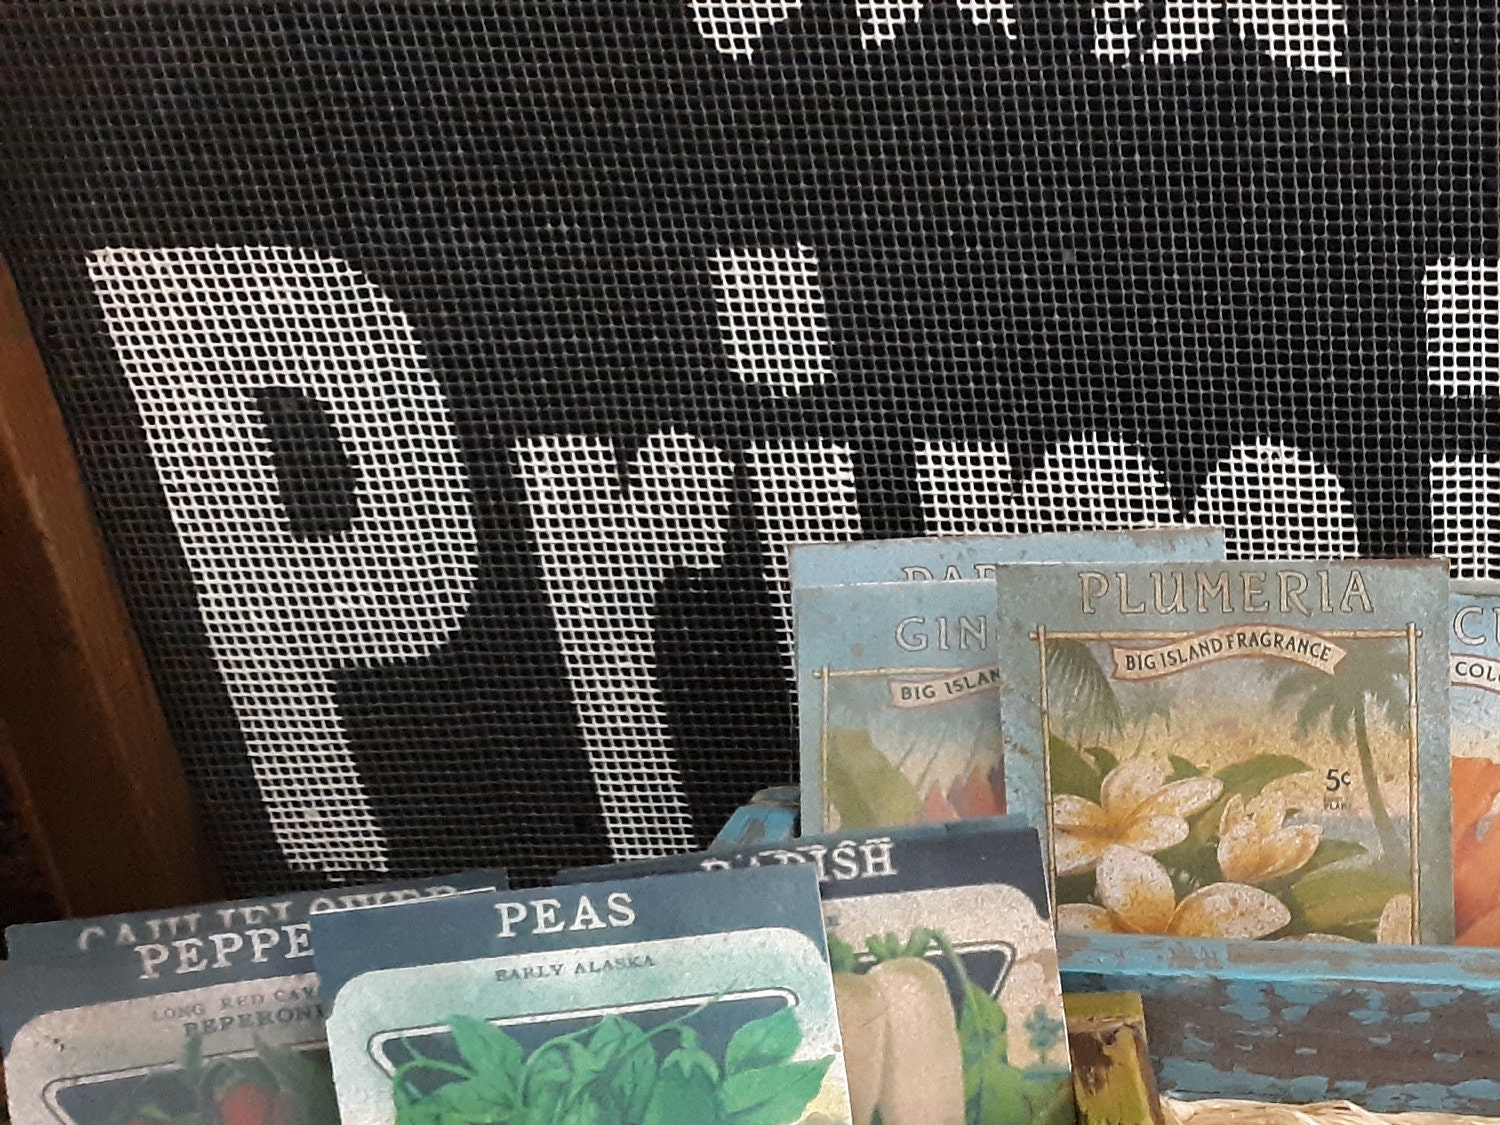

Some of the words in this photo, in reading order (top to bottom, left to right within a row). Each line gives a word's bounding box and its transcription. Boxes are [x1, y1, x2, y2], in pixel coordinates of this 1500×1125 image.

[1078, 570, 1374, 617] PLUMERIA
[895, 615, 998, 652] GIN
[1125, 652, 1156, 671] BIG
[1161, 637, 1223, 668] ISLAND
[1226, 632, 1332, 662] FRAGRANCE
[901, 684, 936, 700] BIG
[494, 892, 636, 938] PEAS
[495, 963, 565, 982] EARLY
[574, 955, 655, 975] ALASKA
